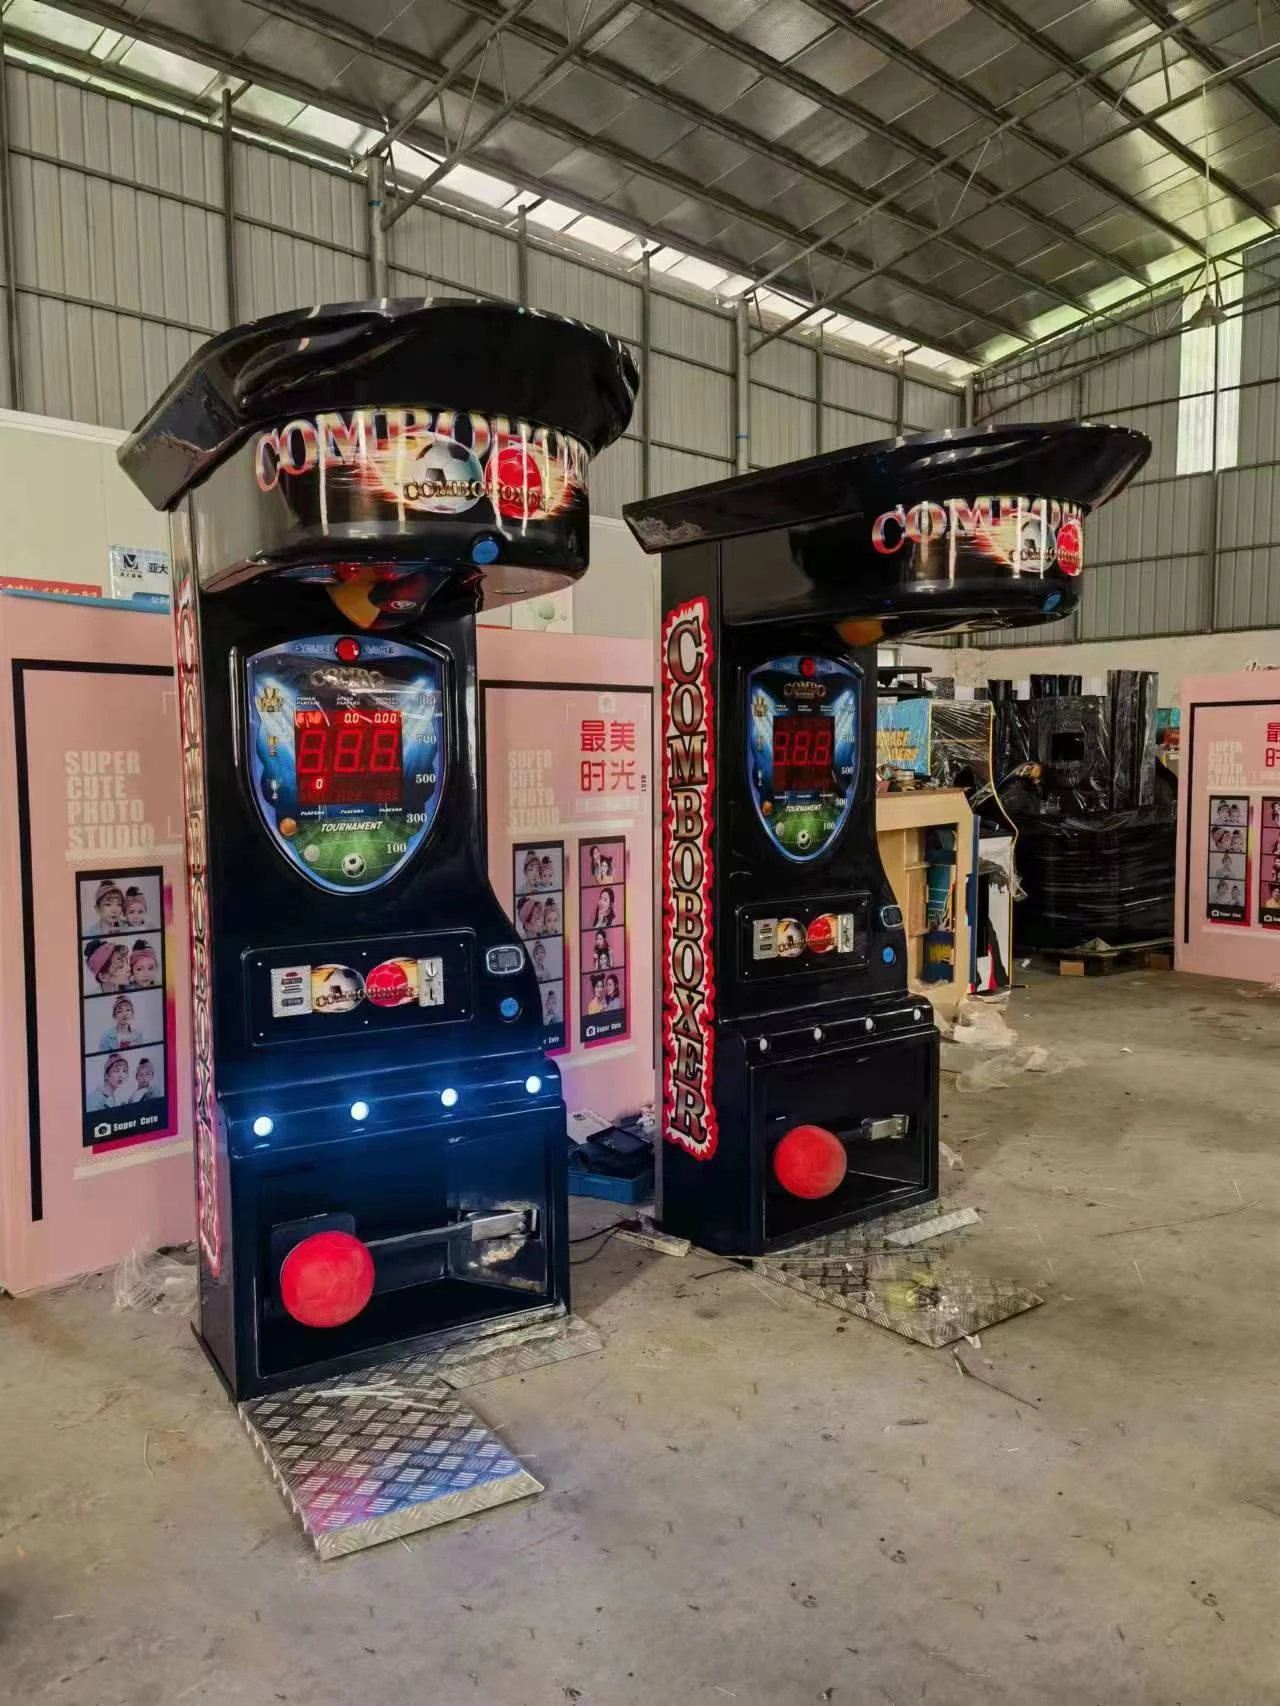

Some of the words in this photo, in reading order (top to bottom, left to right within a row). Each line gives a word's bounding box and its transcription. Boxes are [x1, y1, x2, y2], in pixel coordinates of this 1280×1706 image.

[416, 734, 437, 745] 700
[580, 719, 635, 752] 最美
[65, 750, 140, 776] SUPER
[580, 759, 636, 791] 时光
[841, 766, 854, 775] 500
[315, 778, 323, 789] 0
[415, 773, 436, 784] 500
[67, 775, 127, 800] CUTE
[68, 799, 144, 825] PHOTO
[785, 804, 822, 813] TOURNAMENT
[406, 812, 427, 824] 300
[321, 820, 383, 833] TOURNAMENT
[823, 822, 836, 831] 100
[386, 843, 407, 854] 100
[667, 616, 708, 1147] COMBOBOXER
[113, 1119, 137, 1132] Super
[140, 1115, 158, 1126] Cute
